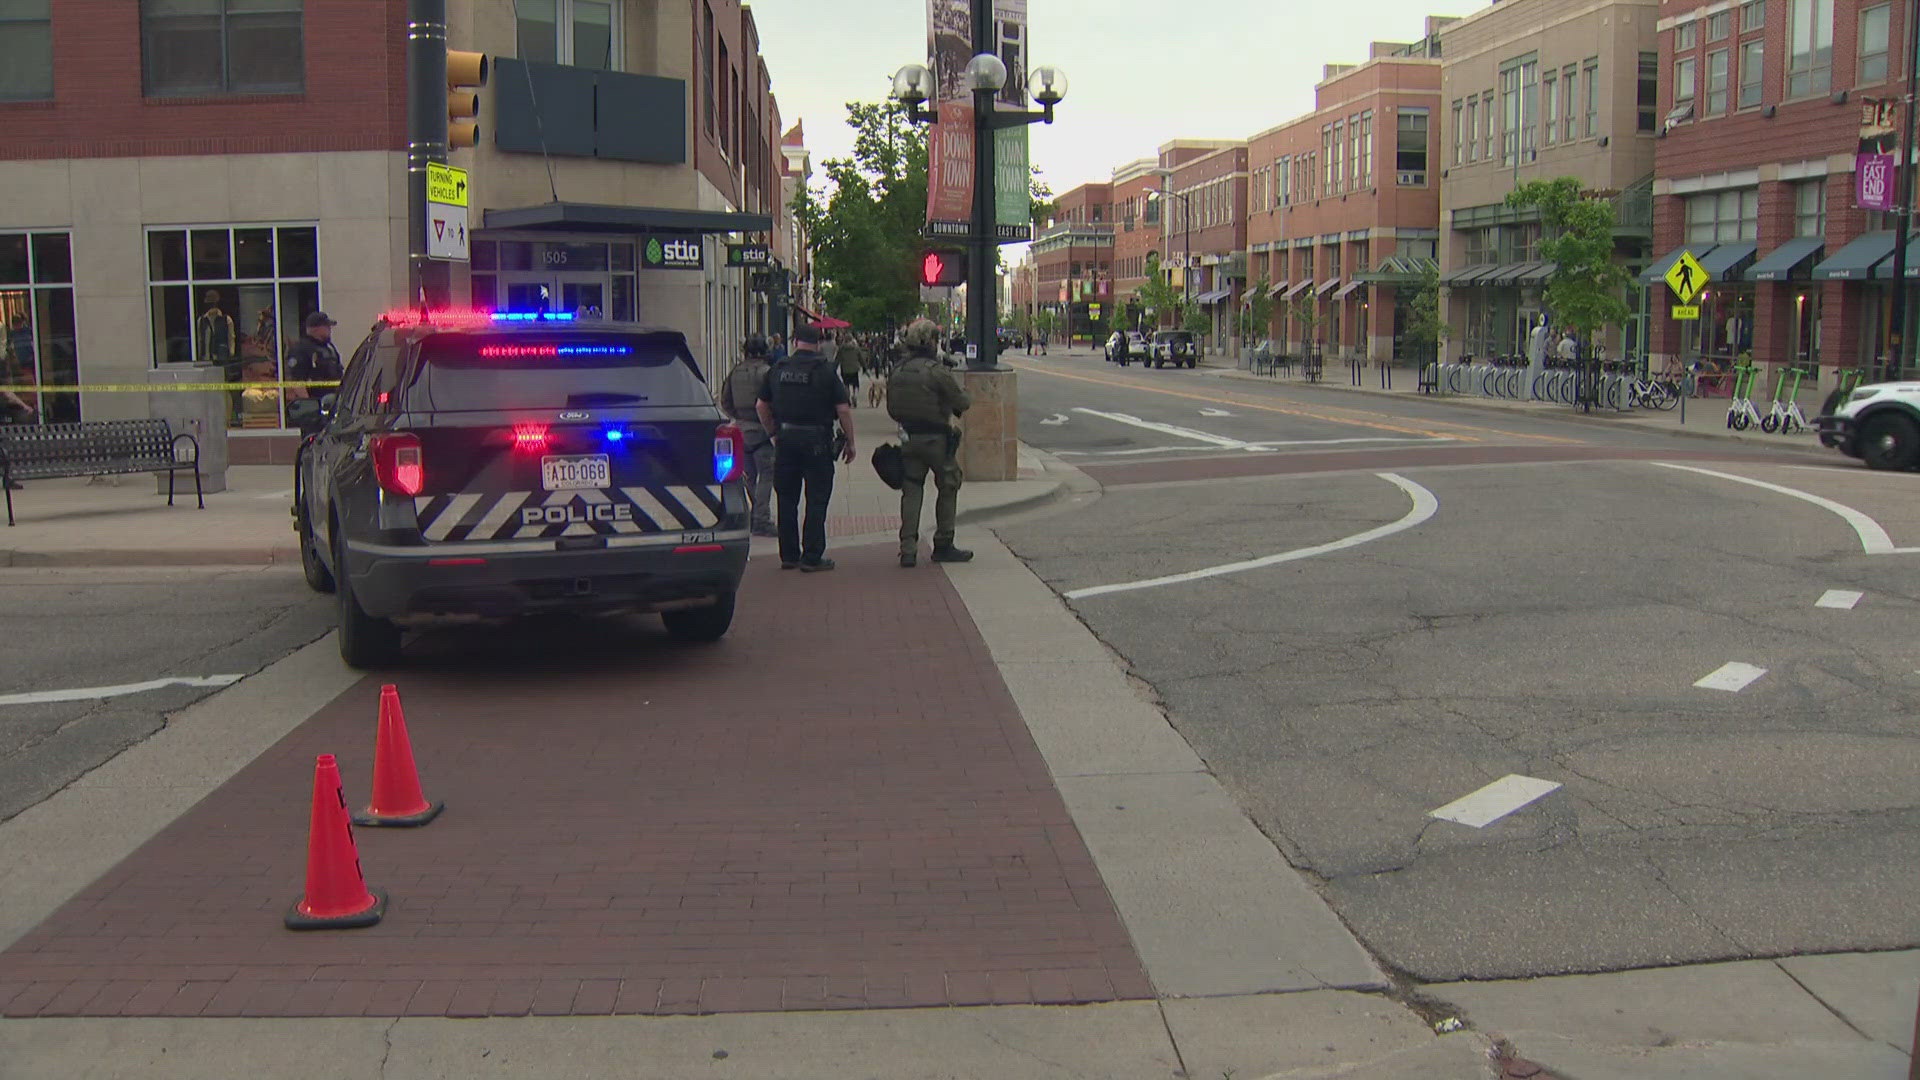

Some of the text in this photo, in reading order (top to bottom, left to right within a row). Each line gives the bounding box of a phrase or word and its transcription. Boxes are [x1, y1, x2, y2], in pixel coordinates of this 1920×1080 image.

[943, 131, 971, 159] DOWN
[430, 170, 453, 185] TURNING
[942, 160, 971, 188] TOWN
[999, 166, 1025, 193] TOWN
[1863, 165, 1886, 180] EAST
[430, 186, 456, 200] VEHICLES
[1863, 180, 1885, 195] END
[933, 221, 969, 234] DOWNTOWN
[997, 226, 1014, 237] EAST
[542, 251, 567, 264] 1505
[664, 239, 700, 261] stio
[743, 249, 765, 260] stio
[780, 370, 809, 385] POLICE
[522, 503, 633, 525] POLICE
